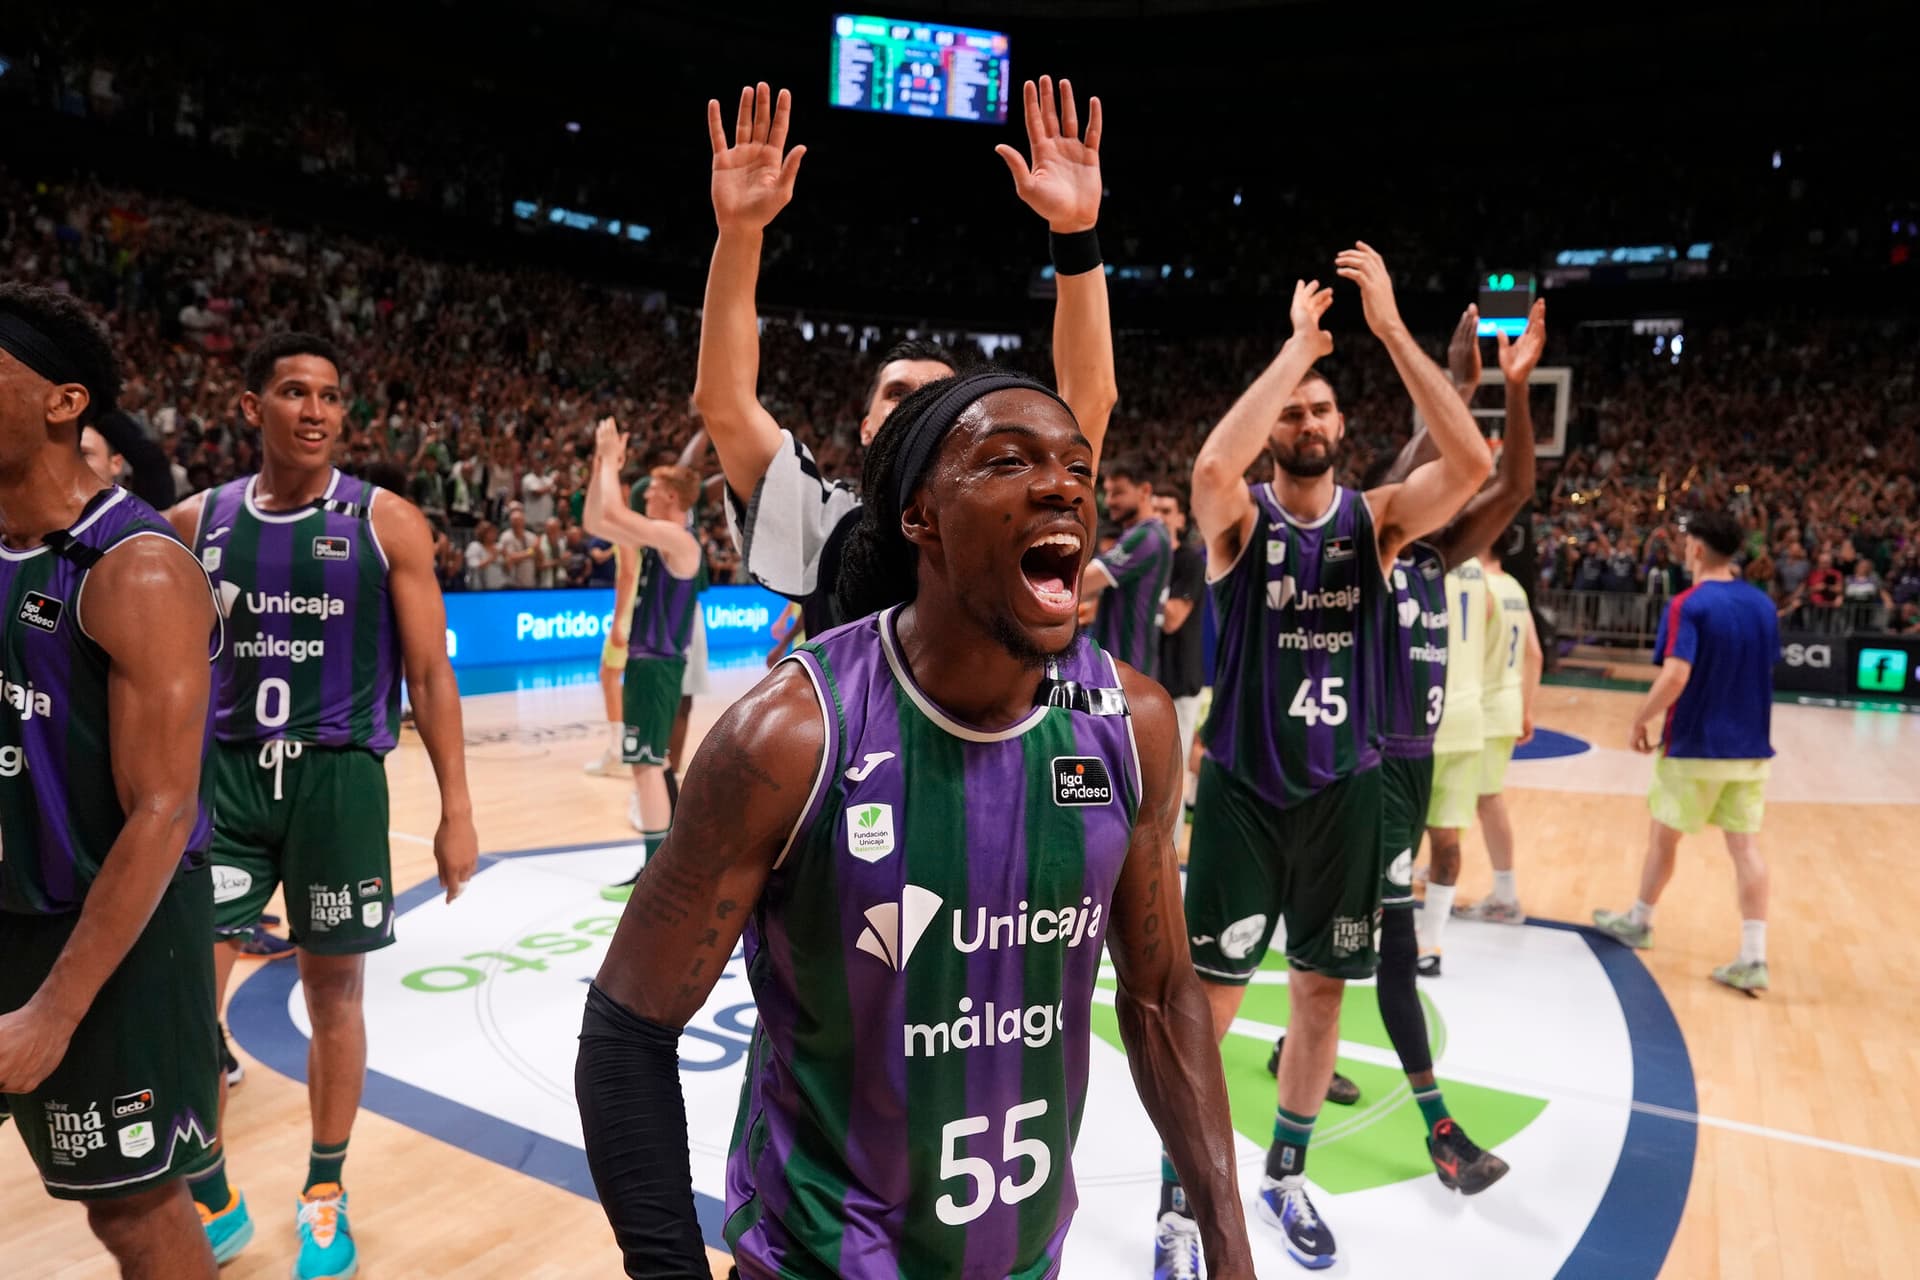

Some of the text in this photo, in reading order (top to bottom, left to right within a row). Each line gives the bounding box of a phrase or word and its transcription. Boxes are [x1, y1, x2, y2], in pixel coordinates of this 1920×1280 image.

[20, 611, 55, 628] endesa
[246, 591, 345, 621] Unicaja
[706, 603, 769, 633] Unicaja
[516, 610, 599, 640] Partido
[255, 677, 291, 728] 0
[1288, 676, 1348, 727] 45
[1060, 771, 1083, 787] liga
[1061, 785, 1109, 799] endesa
[951, 896, 1103, 954] Unicaja
[116, 1101, 146, 1115] acb
[48, 1123, 108, 1158] laga
[935, 1098, 1053, 1227] 55
